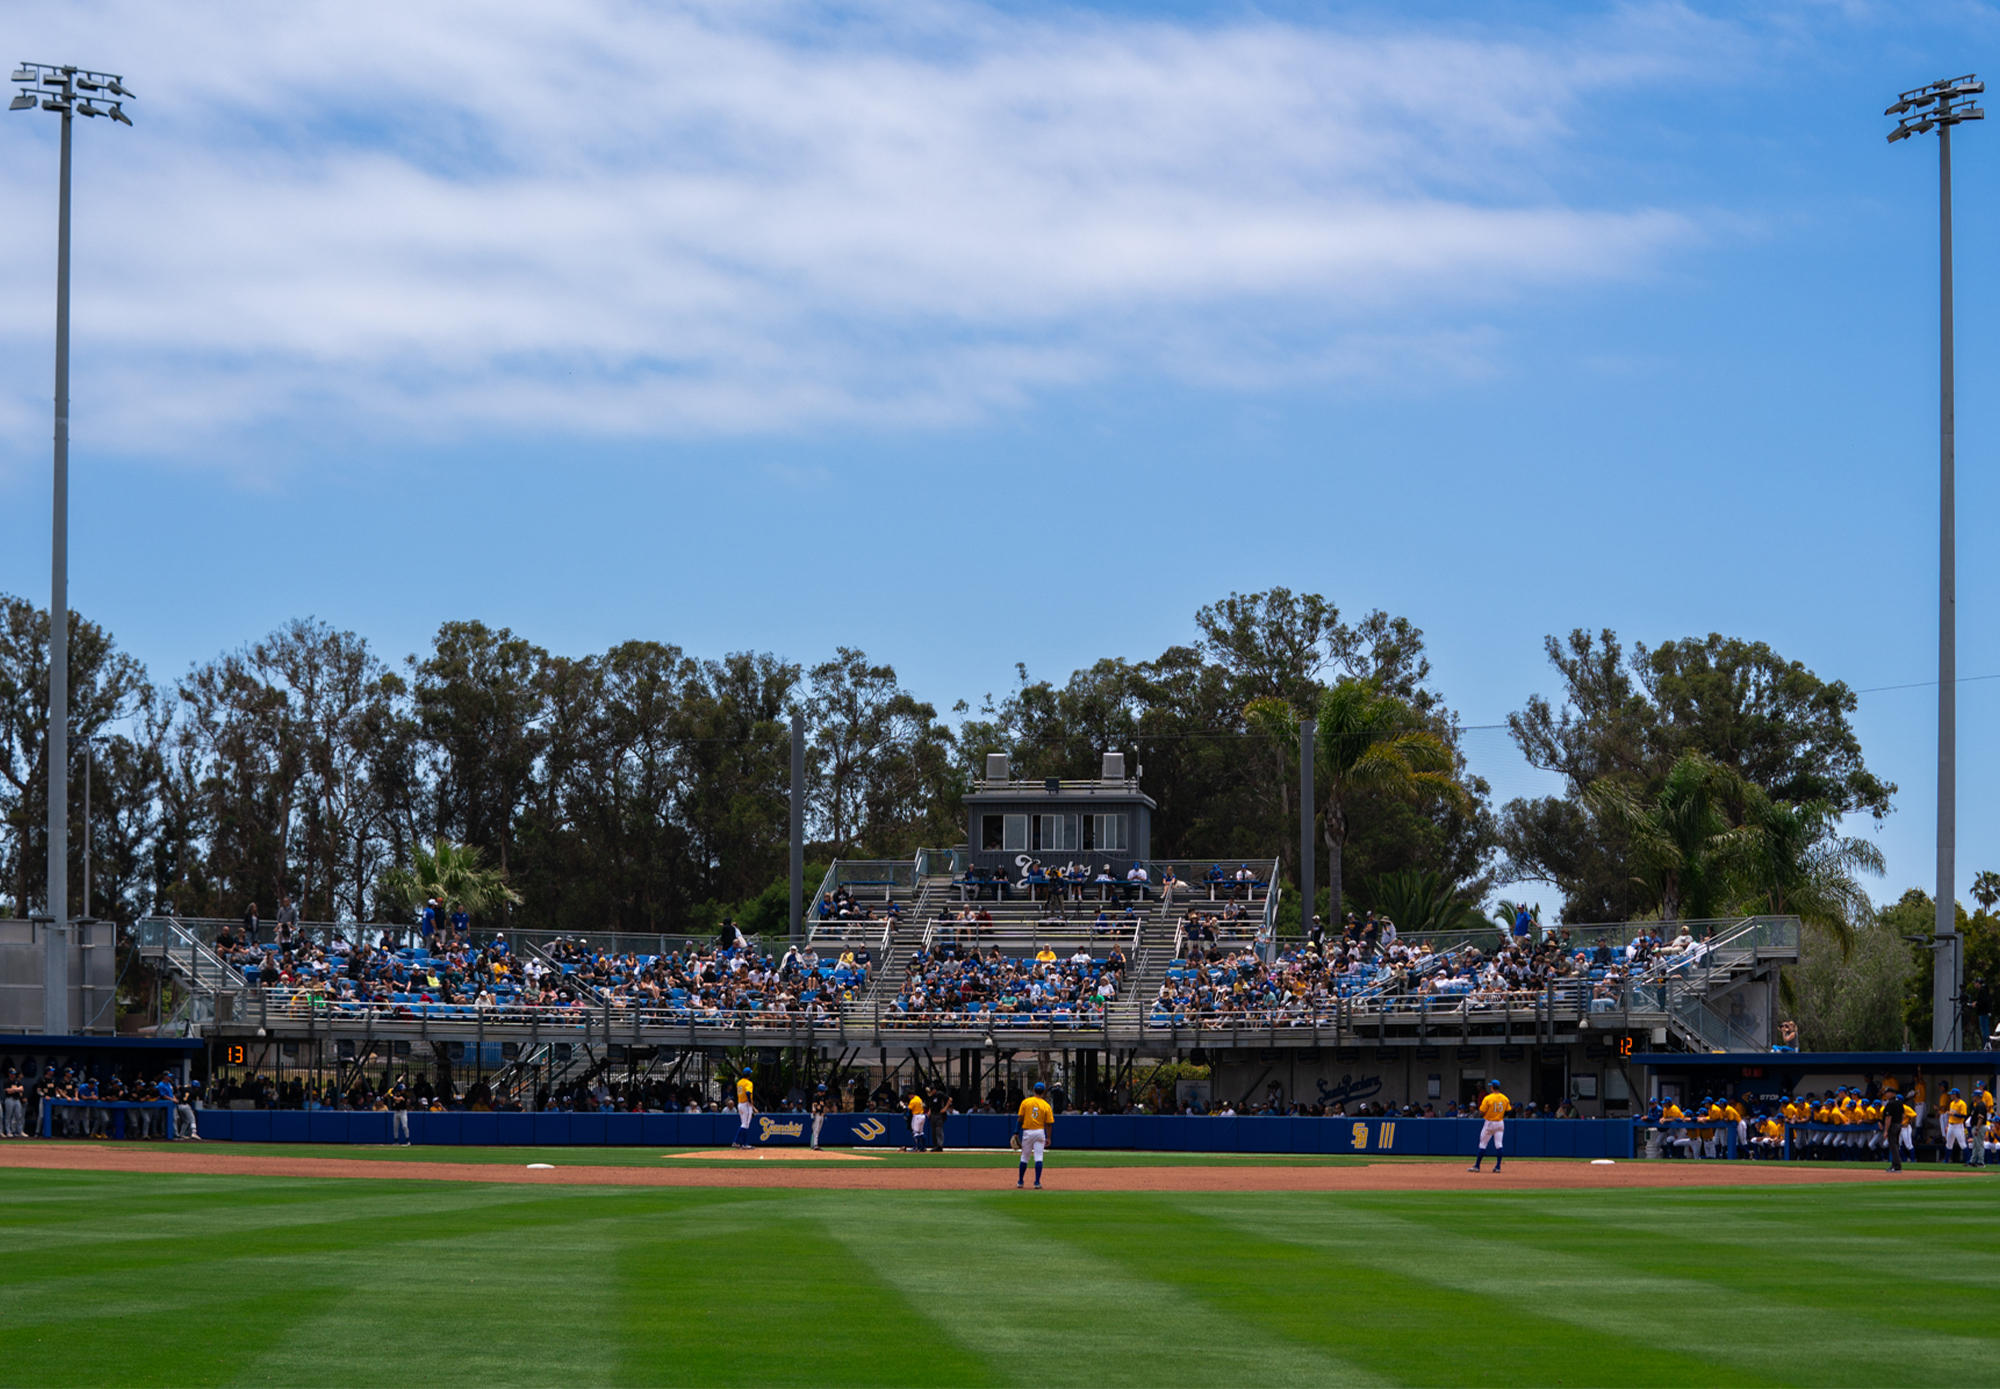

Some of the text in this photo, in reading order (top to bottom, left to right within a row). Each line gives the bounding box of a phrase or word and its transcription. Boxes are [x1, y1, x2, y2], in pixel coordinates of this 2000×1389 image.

[1015, 854, 1092, 889] Gchos
[228, 1045, 244, 1064] 13
[1620, 1037, 1633, 1056] 12
[1031, 1107, 1039, 1119] 5
[759, 1117, 804, 1142] Gauchos
